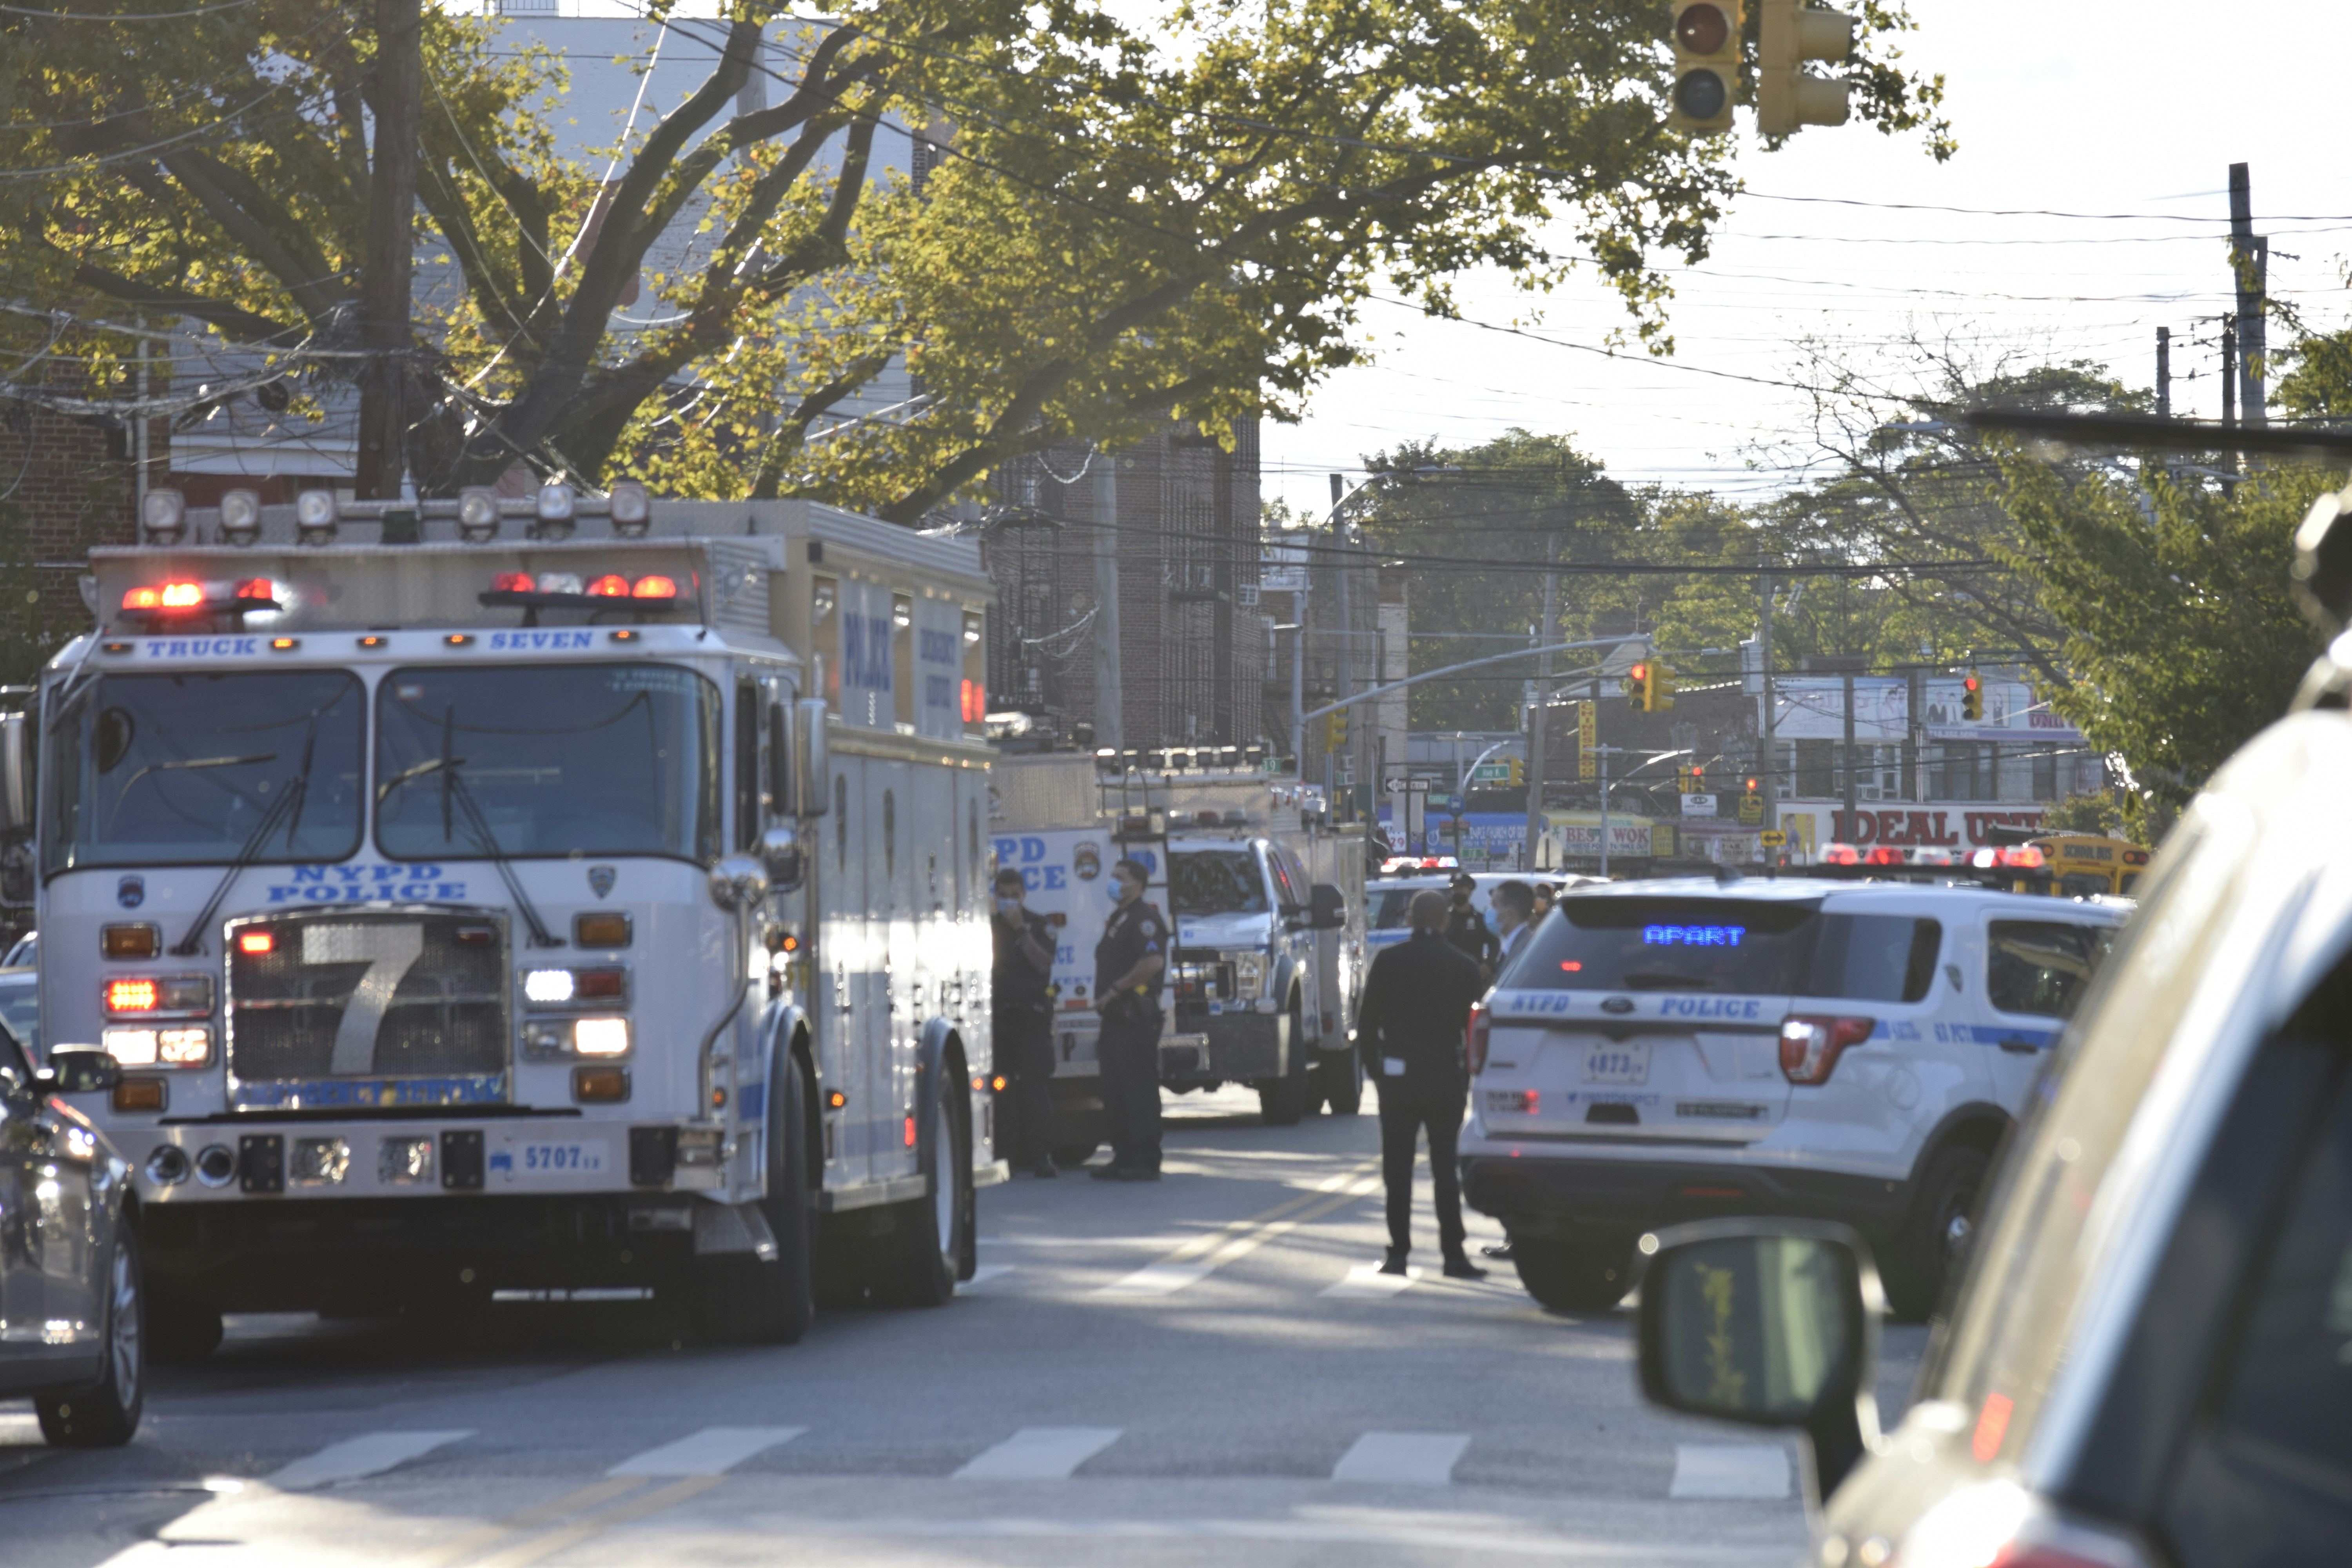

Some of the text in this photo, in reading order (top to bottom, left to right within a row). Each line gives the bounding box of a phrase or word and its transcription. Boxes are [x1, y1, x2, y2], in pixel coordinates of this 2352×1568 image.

[147, 638, 257, 657] TRUCK
[490, 632, 593, 649] SEVEN
[1613, 828, 1649, 842] WOK
[1831, 810, 1959, 845] IDEAL
[2064, 844, 2113, 860] SCHOOL BUS
[292, 866, 443, 883] NYPD
[268, 883, 466, 902] POLICE
[1643, 925, 1745, 946] APART
[302, 923, 424, 1075] 7
[1511, 994, 1760, 1019] NYPD POLICE
[395, 1077, 502, 1103] SERVICE
[526, 1146, 579, 1168] 5707
